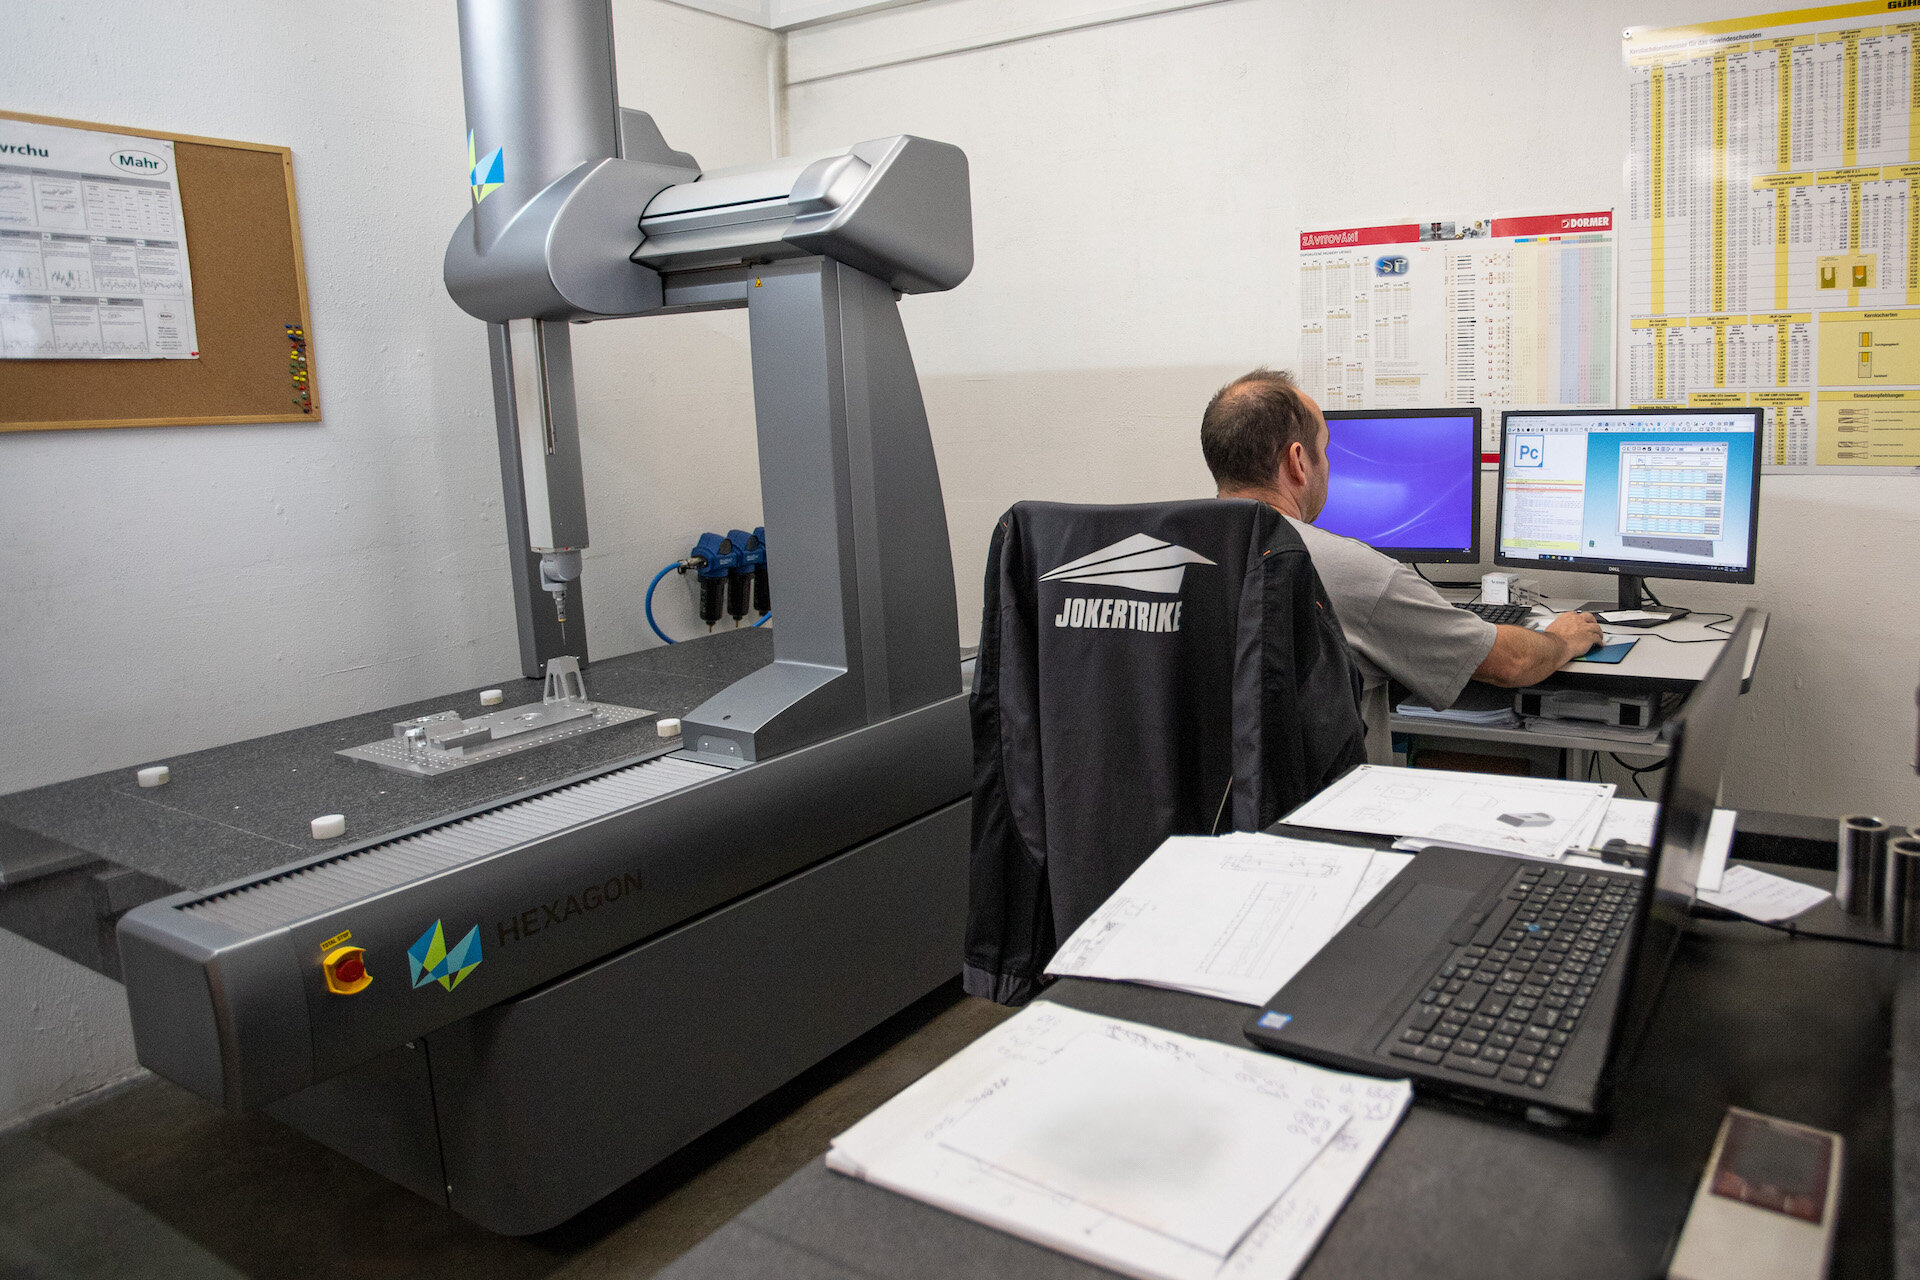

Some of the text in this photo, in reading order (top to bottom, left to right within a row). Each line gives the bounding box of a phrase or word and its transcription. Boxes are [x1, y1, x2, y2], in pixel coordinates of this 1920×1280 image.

[0, 143, 49, 158] vrchu
[119, 154, 160, 170] Mahr
[1570, 216, 1609, 228] DORMER
[1301, 231, 1359, 247] ZÁVITOVÁNÍ
[1519, 445, 1539, 460] Pc
[1054, 597, 1183, 633] JOKERTRIKE
[496, 868, 645, 948] HEXAGON
[322, 932, 349, 949] TOTAL STOP
